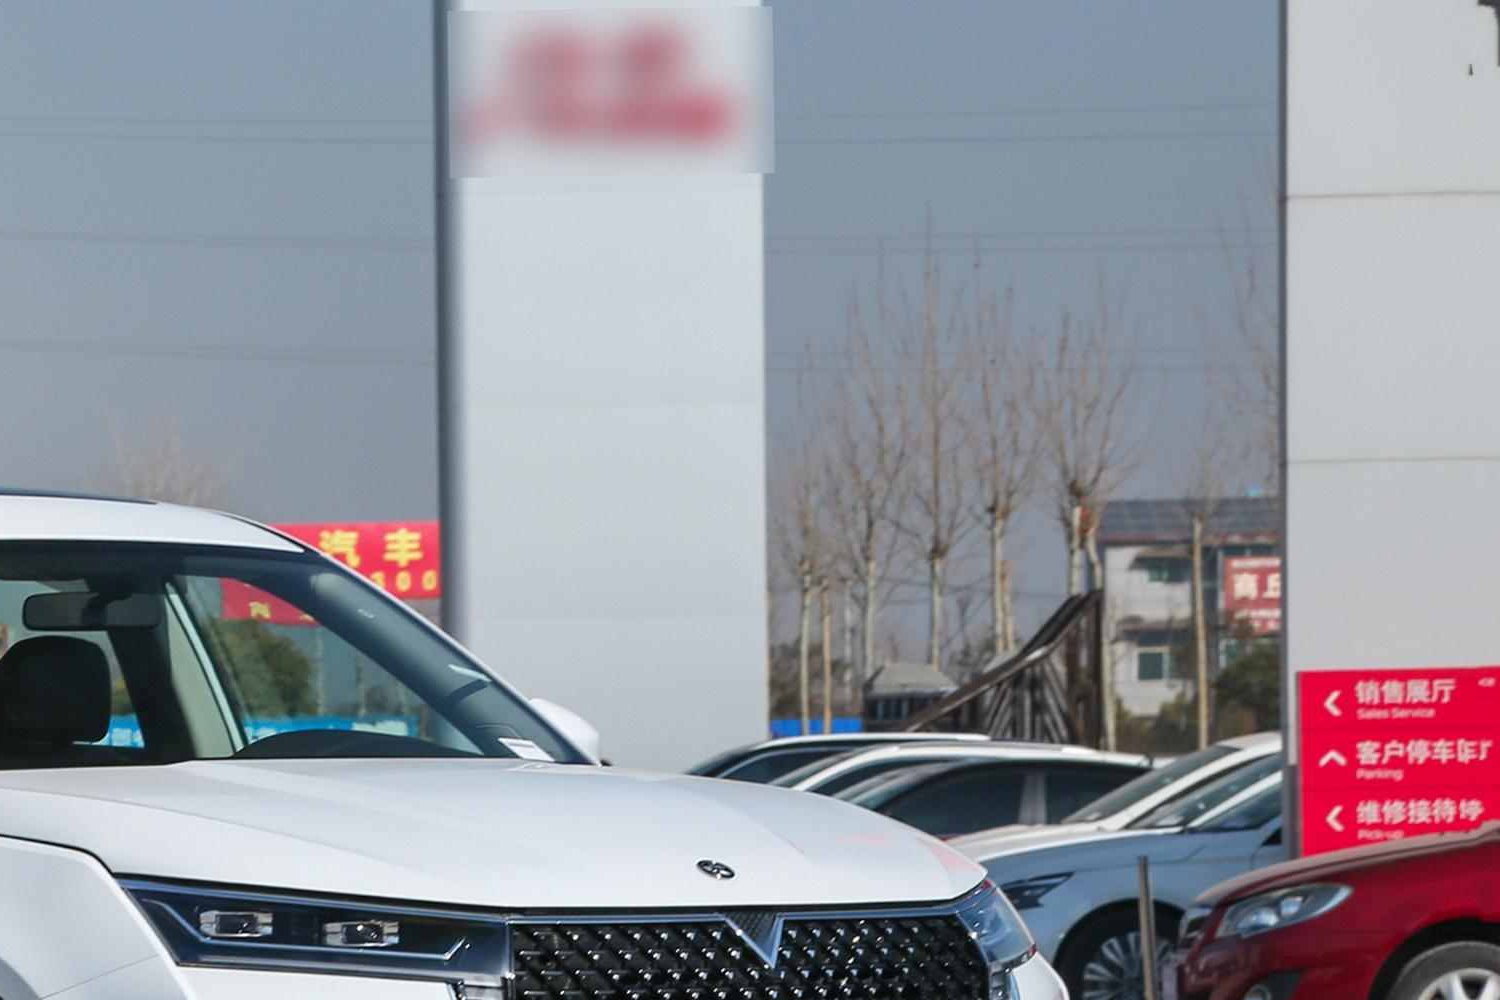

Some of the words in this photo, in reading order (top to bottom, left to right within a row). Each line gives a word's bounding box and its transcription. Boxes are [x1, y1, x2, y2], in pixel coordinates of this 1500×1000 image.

[1355, 678, 1456, 705] 销售展厅
[1356, 707, 1389, 720] Sales
[1391, 707, 1436, 719] Service
[1356, 768, 1405, 782] Parking
